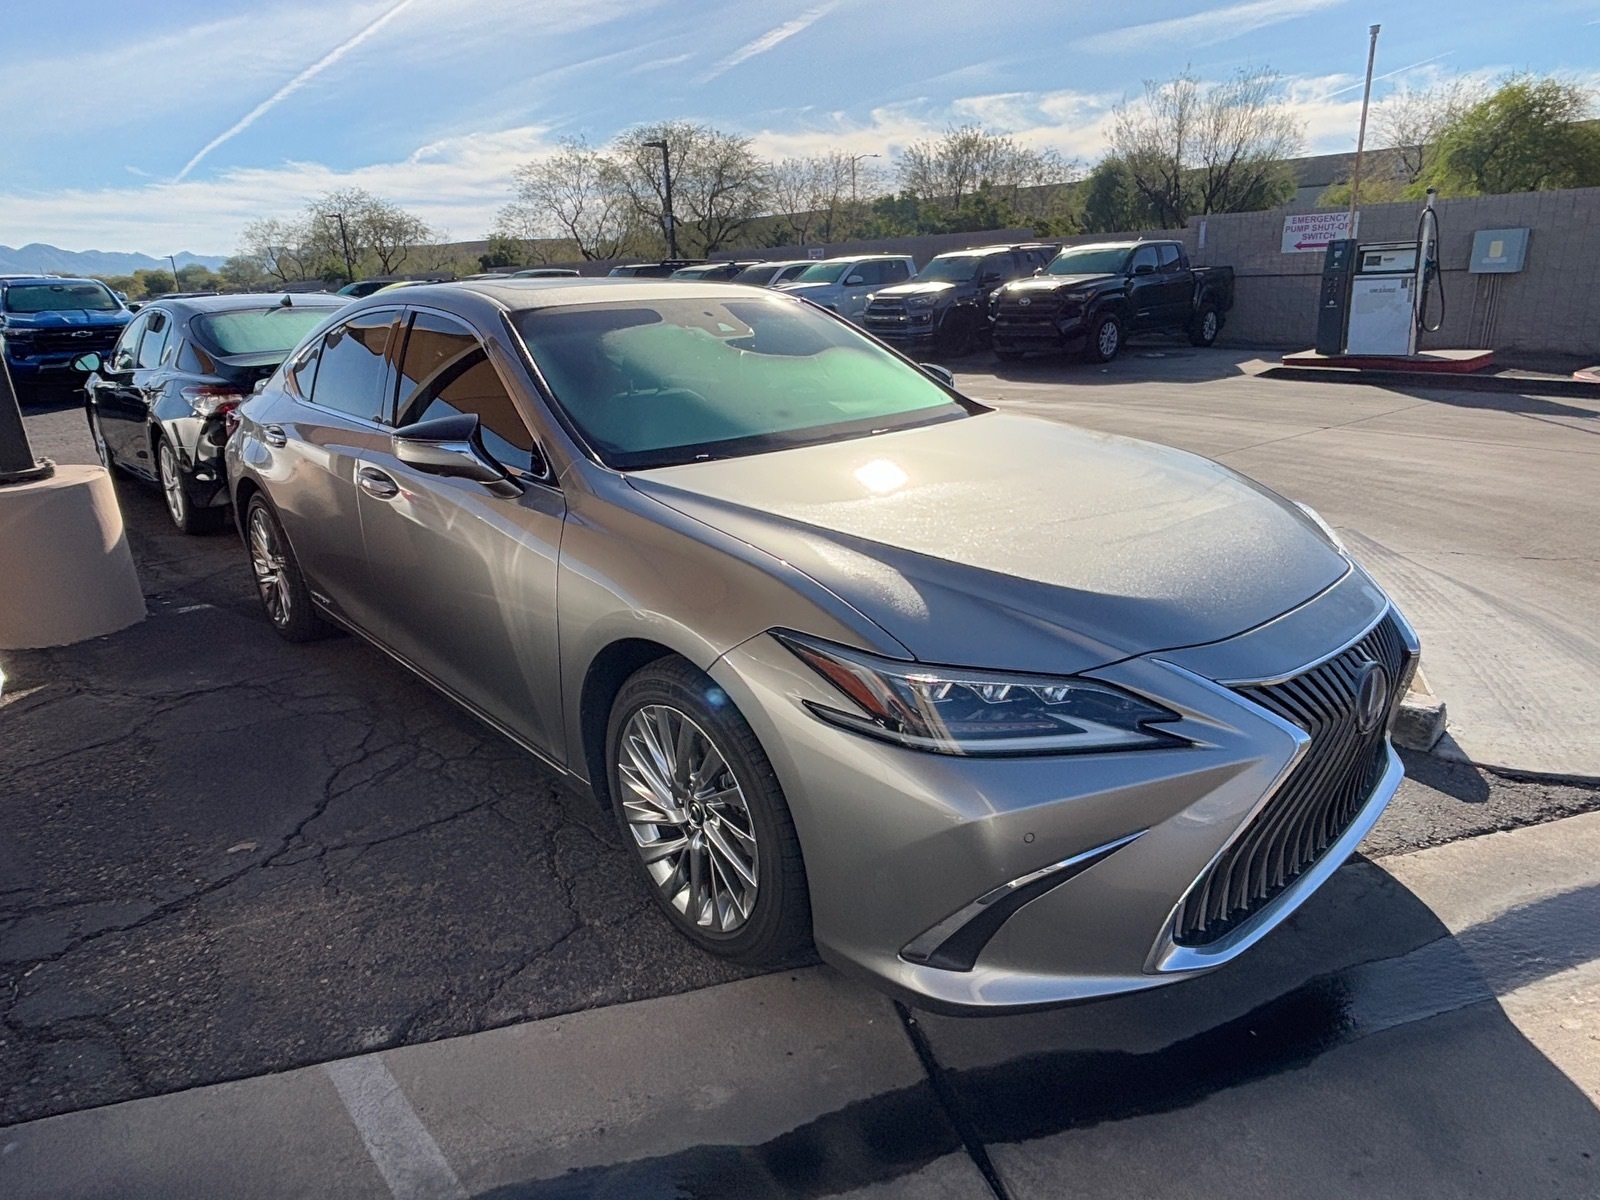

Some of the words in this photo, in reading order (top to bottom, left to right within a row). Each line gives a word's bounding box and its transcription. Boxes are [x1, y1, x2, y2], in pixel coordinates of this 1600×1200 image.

[1292, 214, 1348, 224] EMERGENCY
[1285, 225, 1310, 233] PUMP
[1311, 222, 1355, 232] SHUT-OF
[1302, 232, 1336, 240] SWITCH
